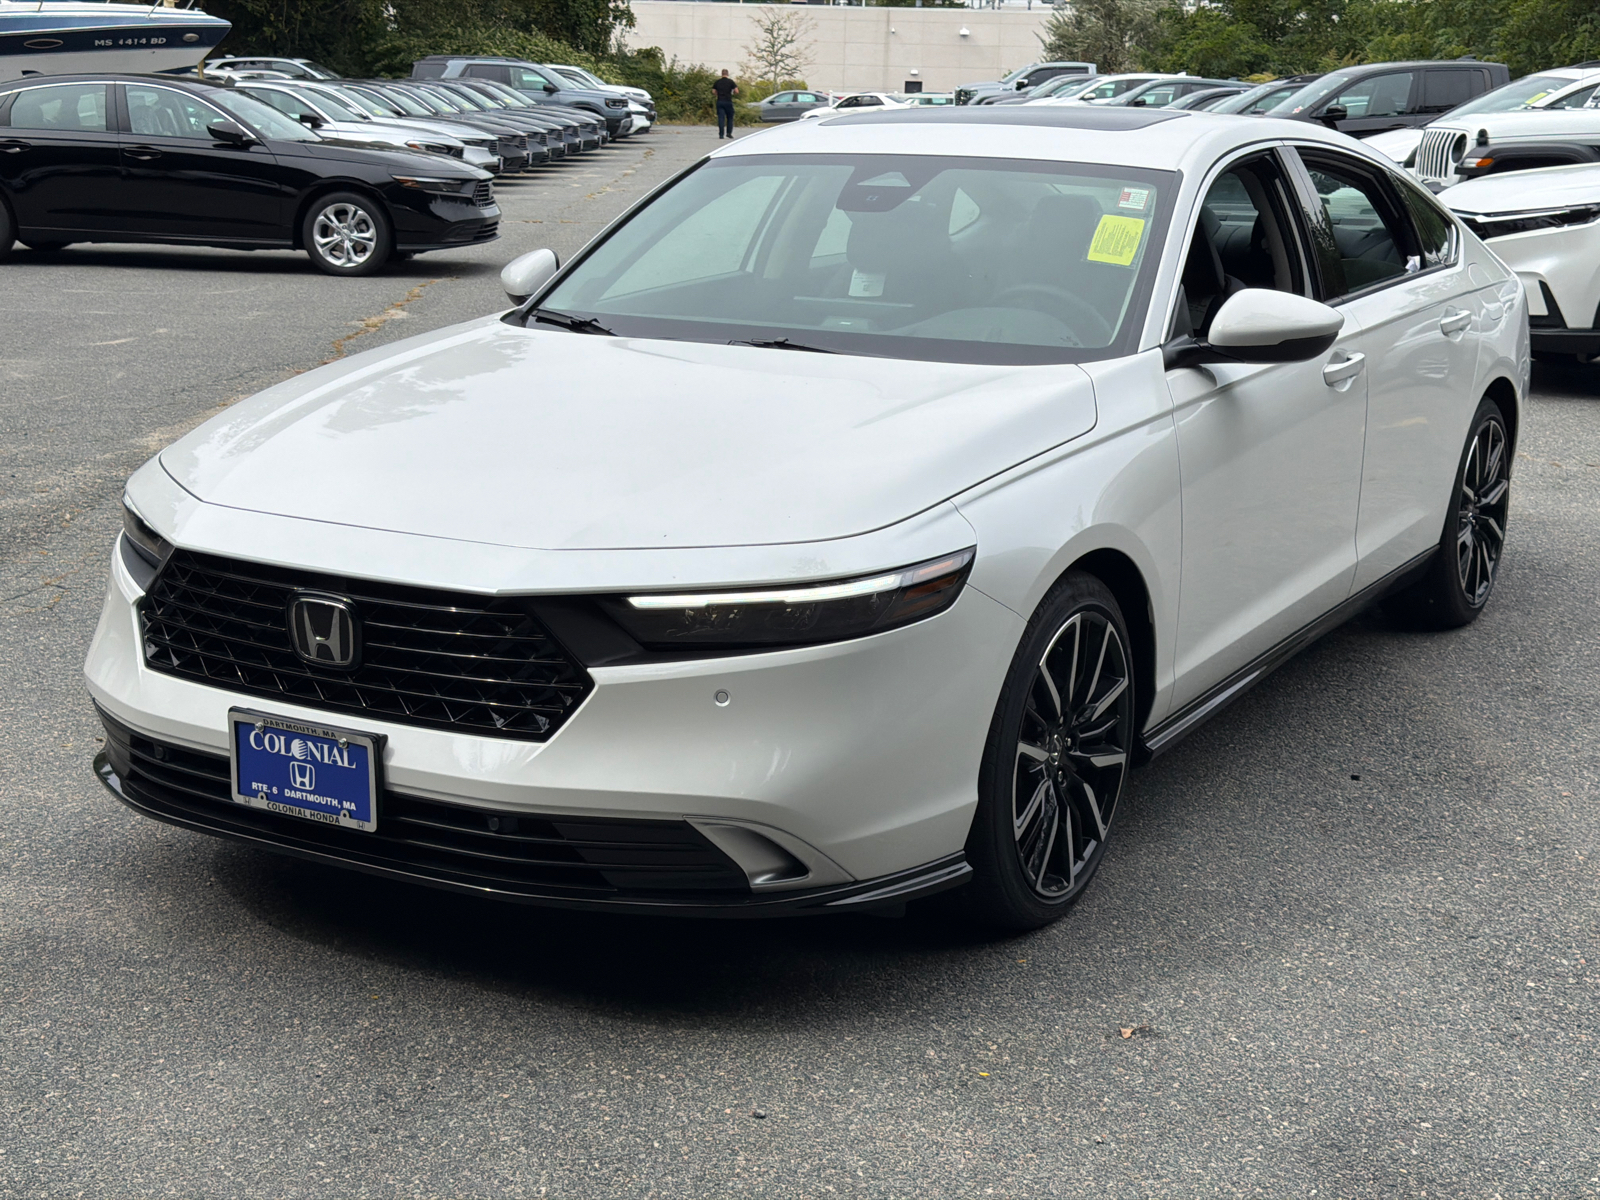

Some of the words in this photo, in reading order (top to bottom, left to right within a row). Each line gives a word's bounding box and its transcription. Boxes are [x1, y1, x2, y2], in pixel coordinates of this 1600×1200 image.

[94, 39, 113, 47] MS
[150, 37, 167, 45] BD
[323, 730, 337, 739] MA
[249, 730, 357, 769] COLONIAL
[251, 782, 270, 793] RTE.
[272, 786, 278, 795] 6
[284, 788, 341, 809] DARTMOUTH,
[342, 800, 357, 811] MA
[266, 801, 308, 818] COLONIAL
[309, 809, 341, 825] HONDA
